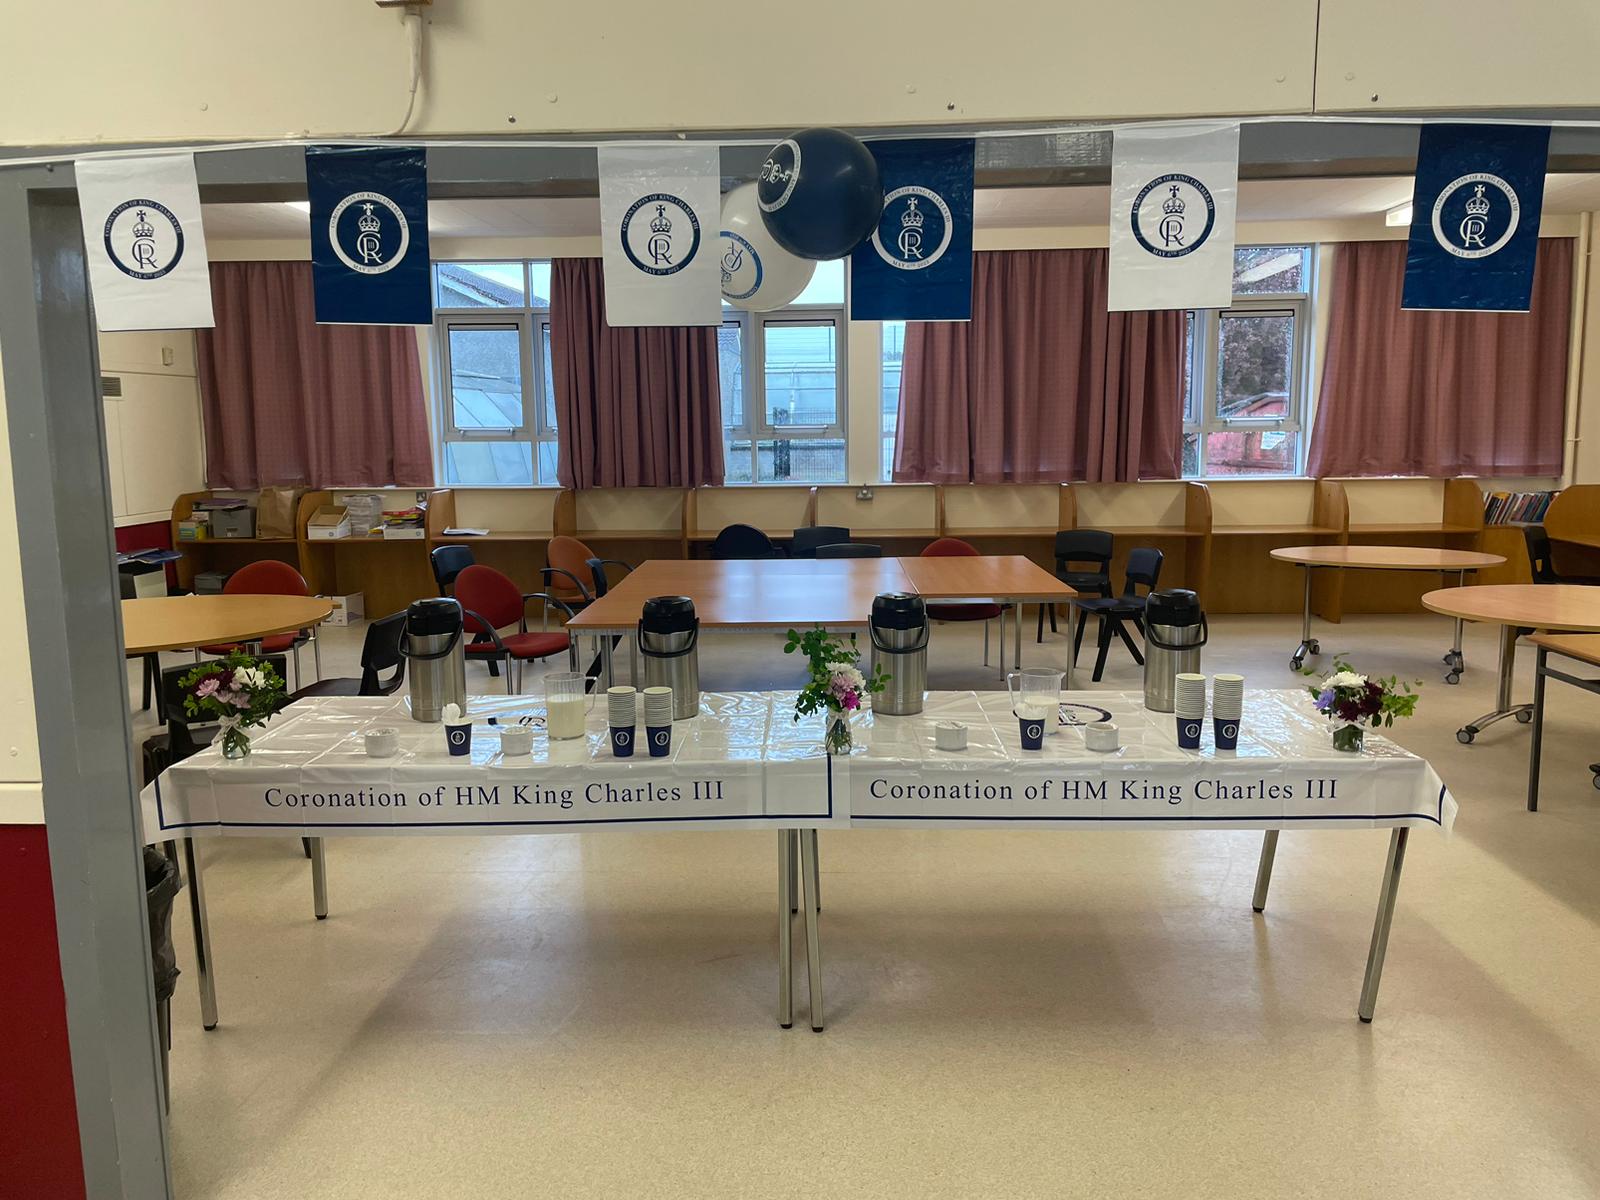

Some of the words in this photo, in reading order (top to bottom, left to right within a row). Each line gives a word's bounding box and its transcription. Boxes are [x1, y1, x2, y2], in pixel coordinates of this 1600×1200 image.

[264, 787, 407, 807] Coronation
[418, 786, 446, 806] of
[456, 786, 500, 806] HM
[512, 784, 574, 809] King
[585, 782, 681, 804] Charles
[692, 780, 724, 800] III
[870, 779, 1013, 800] Coronation
[1024, 780, 1053, 800] of
[1062, 780, 1108, 800] HM
[1120, 780, 1182, 804] King
[1194, 780, 1294, 800] Charles
[1306, 779, 1338, 799] III
